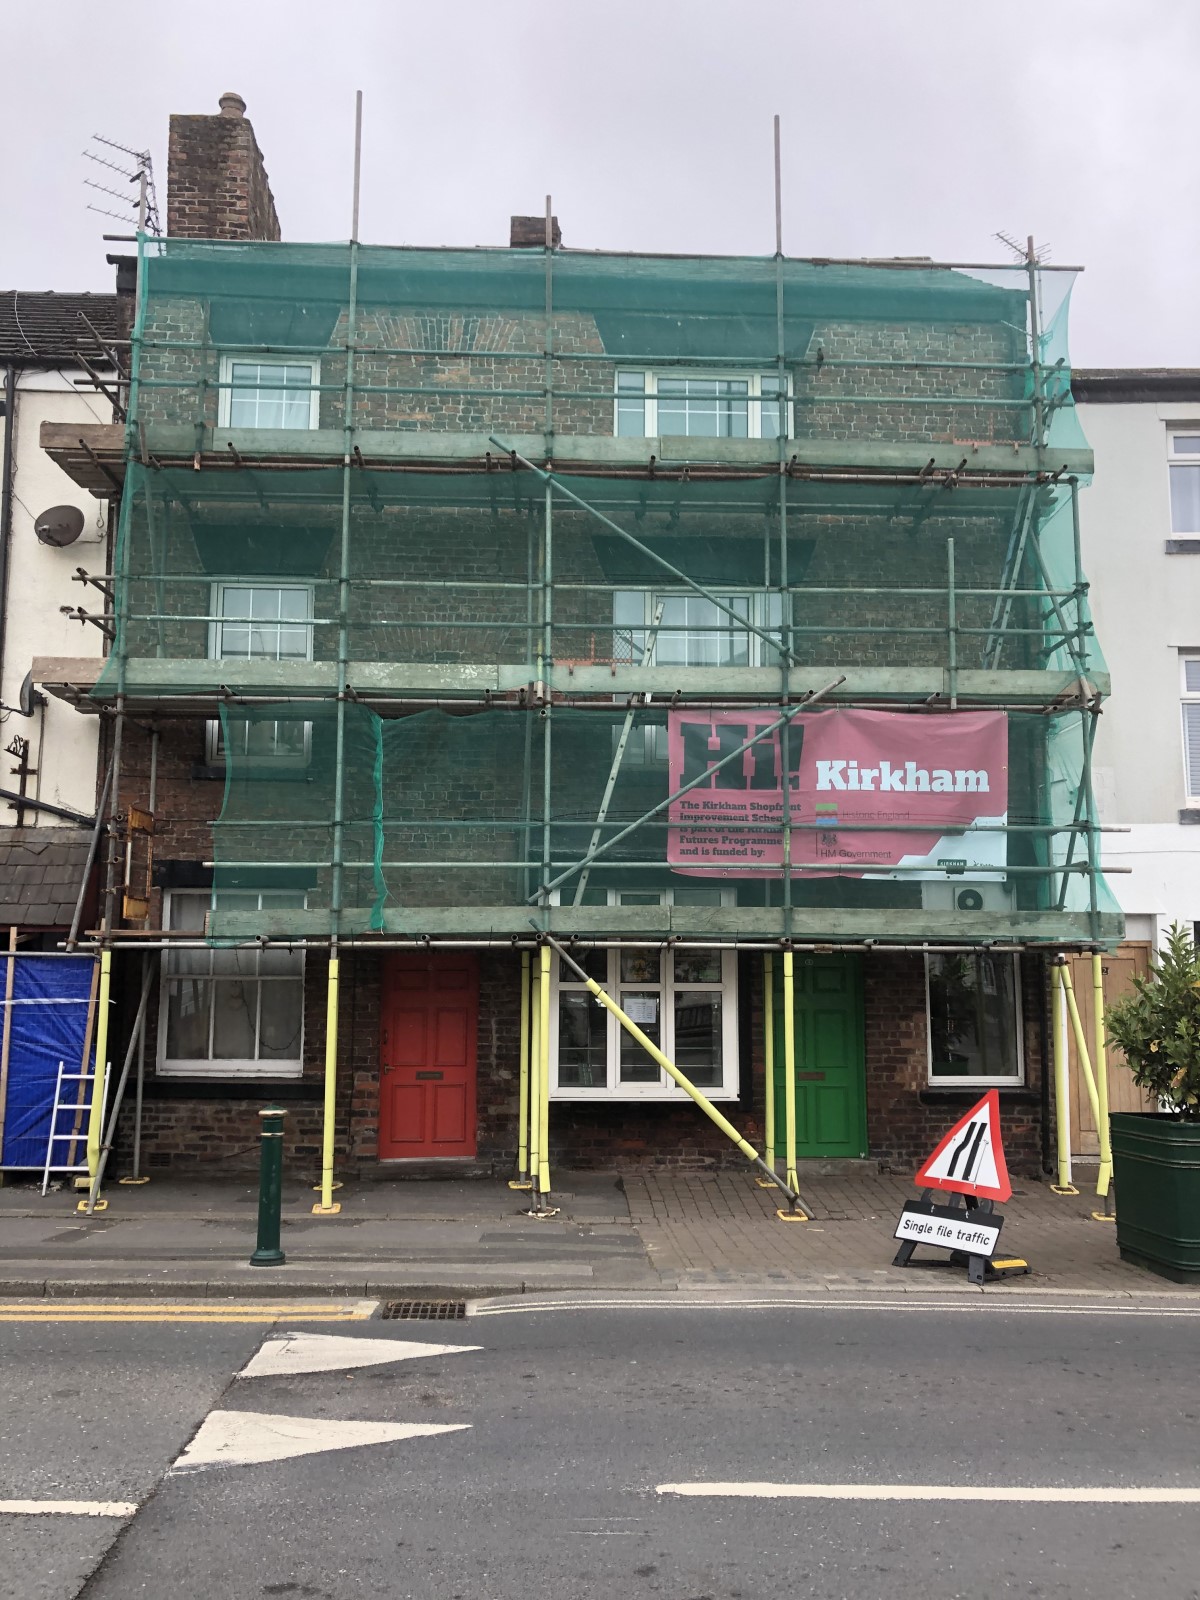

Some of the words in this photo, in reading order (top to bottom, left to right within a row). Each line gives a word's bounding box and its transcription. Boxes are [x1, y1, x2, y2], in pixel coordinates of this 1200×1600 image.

[680, 722, 804, 790] Hi!
[816, 760, 989, 792] Kirkham
[680, 801, 700, 810] The
[702, 802, 746, 810] Kirkham
[750, 802, 801, 812] Shopfrnt
[680, 813, 749, 822] Improvement
[752, 814, 792, 822] Schem
[878, 811, 910, 821] England
[680, 835, 719, 844] Futures
[722, 836, 782, 846] Programme
[680, 847, 698, 856] and
[702, 847, 710, 856] is
[712, 847, 747, 856] funded
[751, 848, 765, 858] by:
[820, 850, 836, 858] HM
[839, 849, 891, 858] Government
[903, 1219, 933, 1234] Single
[936, 1225, 953, 1238] file
[956, 1229, 990, 1245] traffic
